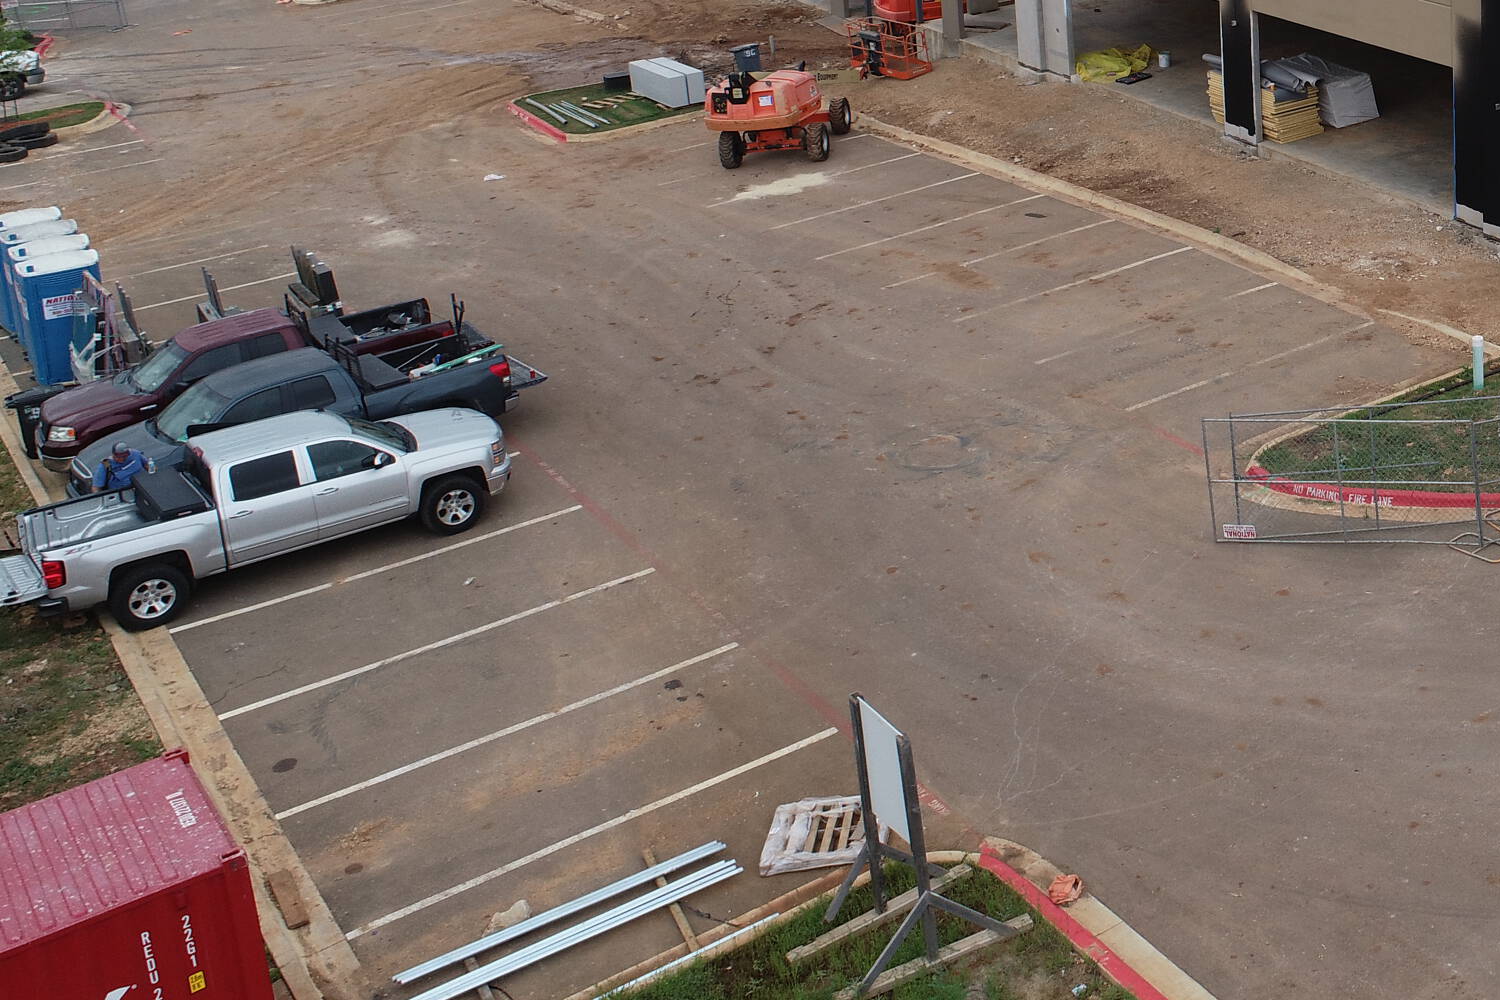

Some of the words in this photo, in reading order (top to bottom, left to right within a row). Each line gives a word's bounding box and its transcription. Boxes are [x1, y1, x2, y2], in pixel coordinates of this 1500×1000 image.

[1293, 484, 1304, 494] NO
[1348, 493, 1368, 505] FIRE
[1224, 530, 1256, 538] NATIONAL
[140, 931, 159, 985] REDU
[181, 914, 198, 968] 22G1
